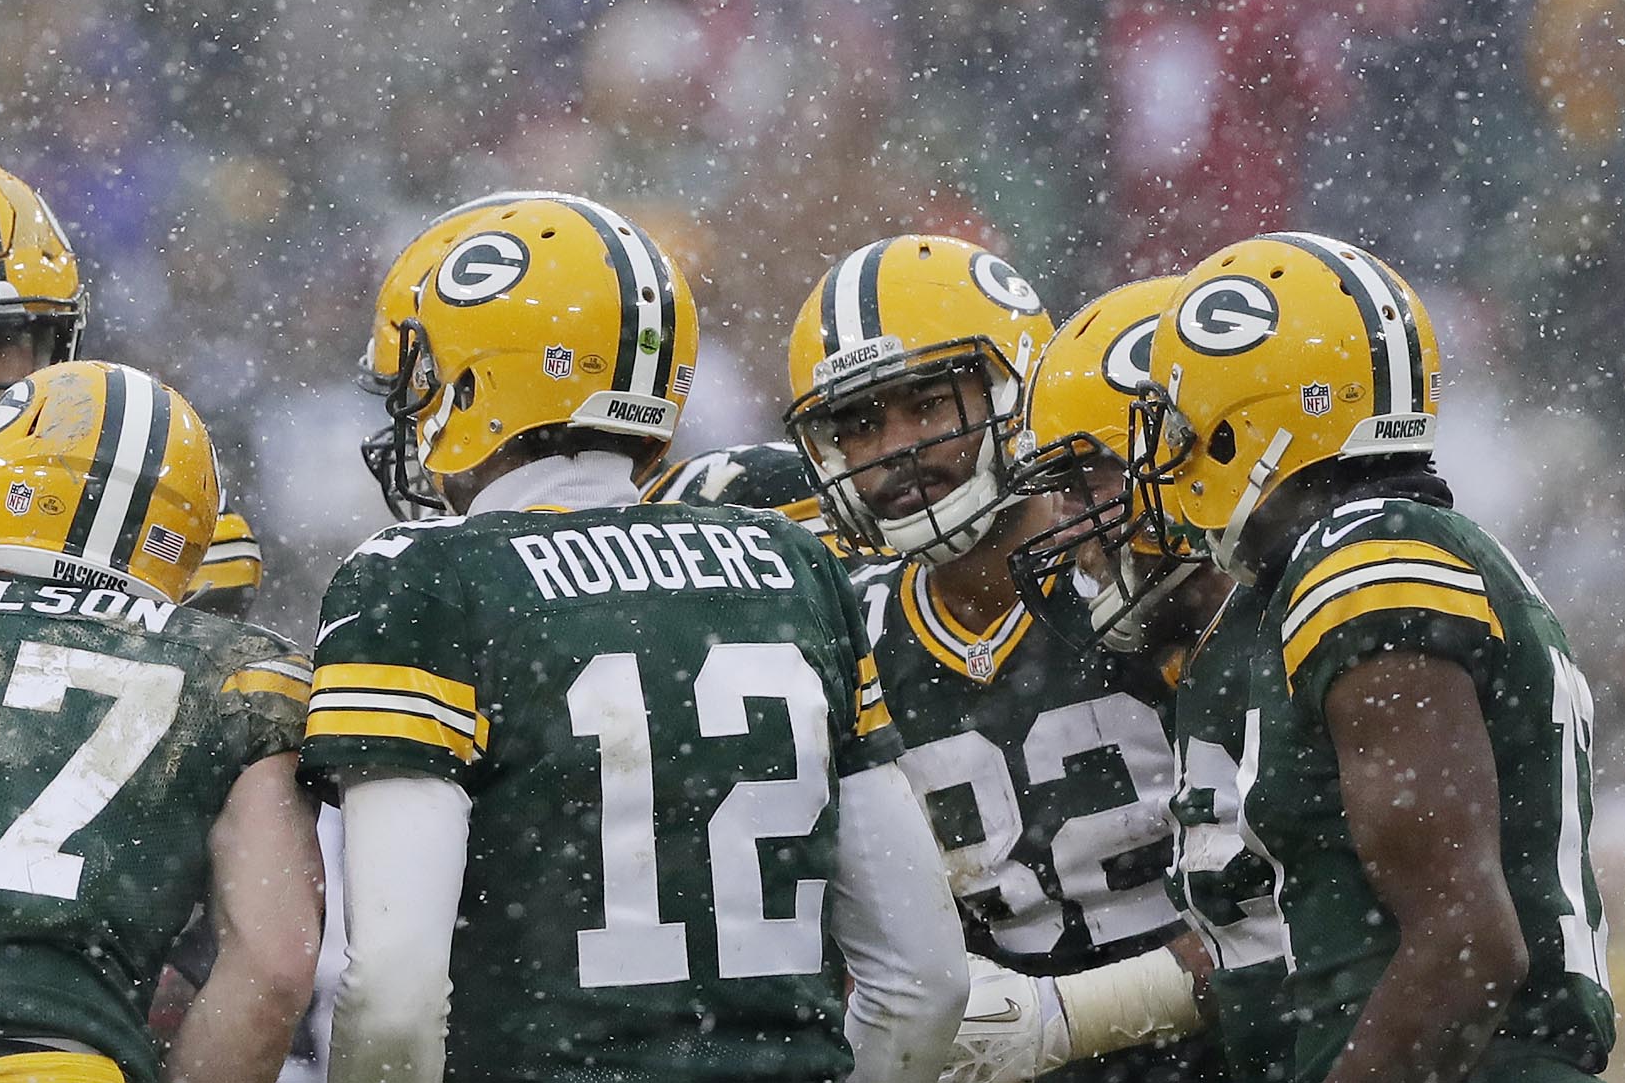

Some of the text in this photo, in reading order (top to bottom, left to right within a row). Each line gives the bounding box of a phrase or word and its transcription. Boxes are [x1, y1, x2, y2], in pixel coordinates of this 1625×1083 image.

[439, 233, 527, 303] G
[1179, 278, 1277, 351] G
[547, 359, 568, 375] NFL
[831, 344, 879, 373] PACKERS
[607, 399, 666, 425] PACKERS
[1306, 397, 1327, 412] NFL
[1375, 418, 1427, 439] PACKERS
[53, 559, 129, 593] PACKERS
[509, 522, 795, 603] RODGERS
[566, 643, 831, 988] 12
[895, 691, 1187, 954] 82
